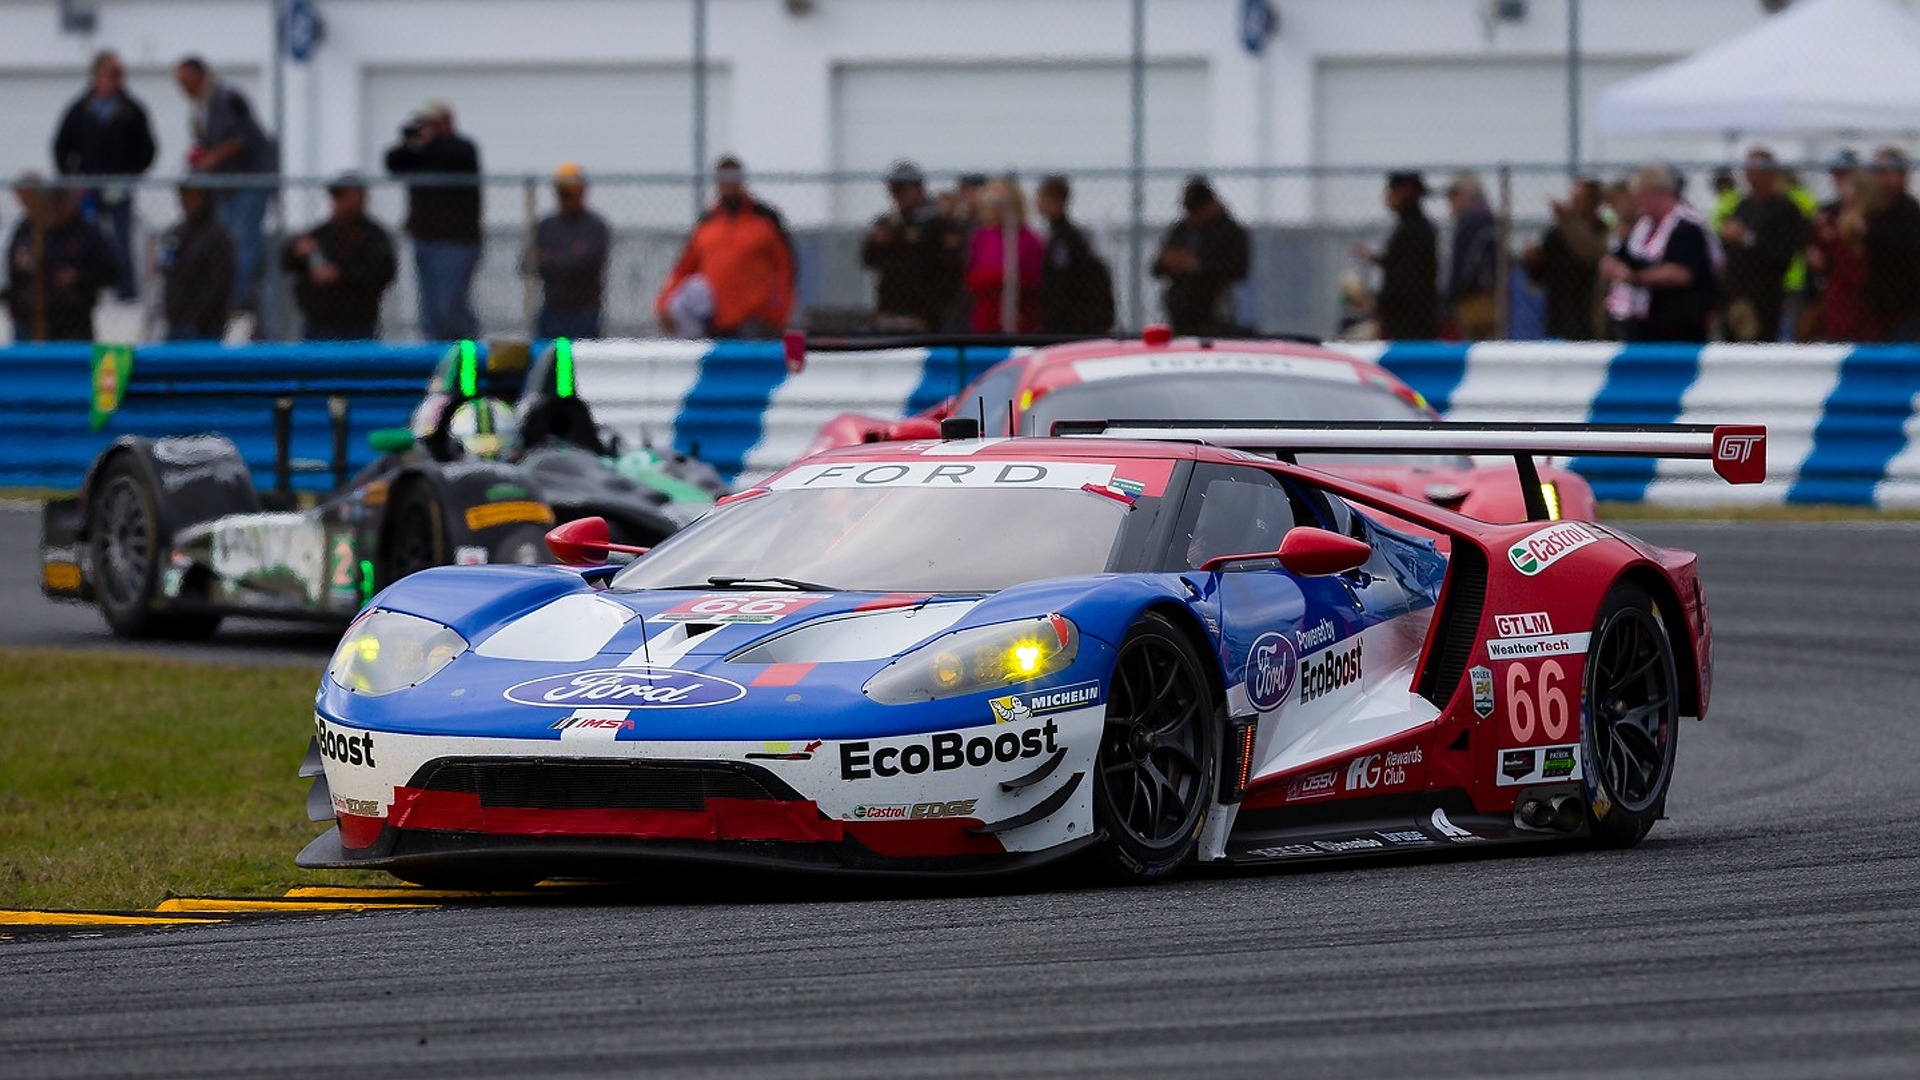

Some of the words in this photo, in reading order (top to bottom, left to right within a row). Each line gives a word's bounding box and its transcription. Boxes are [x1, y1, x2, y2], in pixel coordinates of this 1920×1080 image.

[1717, 434, 1765, 464] GT
[803, 464, 1048, 485] FORD
[1528, 525, 1590, 562] Castrol
[332, 541, 353, 584] 2
[690, 597, 798, 614] 66
[1296, 619, 1325, 652] Powered
[1323, 618, 1336, 642] by
[1499, 614, 1550, 636] GTLM
[1490, 639, 1569, 656] WeatherTech
[1255, 643, 1287, 699] Ford
[1300, 638, 1363, 706] EcoBoost
[1471, 670, 1491, 679] ROLEX
[543, 672, 703, 703] Ford
[1031, 686, 1099, 710] MICHELIN
[1475, 681, 1491, 695] 24
[1506, 659, 1569, 743] 66
[575, 717, 635, 731] IMSA
[764, 741, 789, 754] TOW
[839, 718, 1058, 781] EcoBoost
[1385, 745, 1422, 767] Rewards
[1384, 766, 1405, 786] Club
[867, 805, 906, 818] Castrol
[910, 798, 979, 819] EDGE
